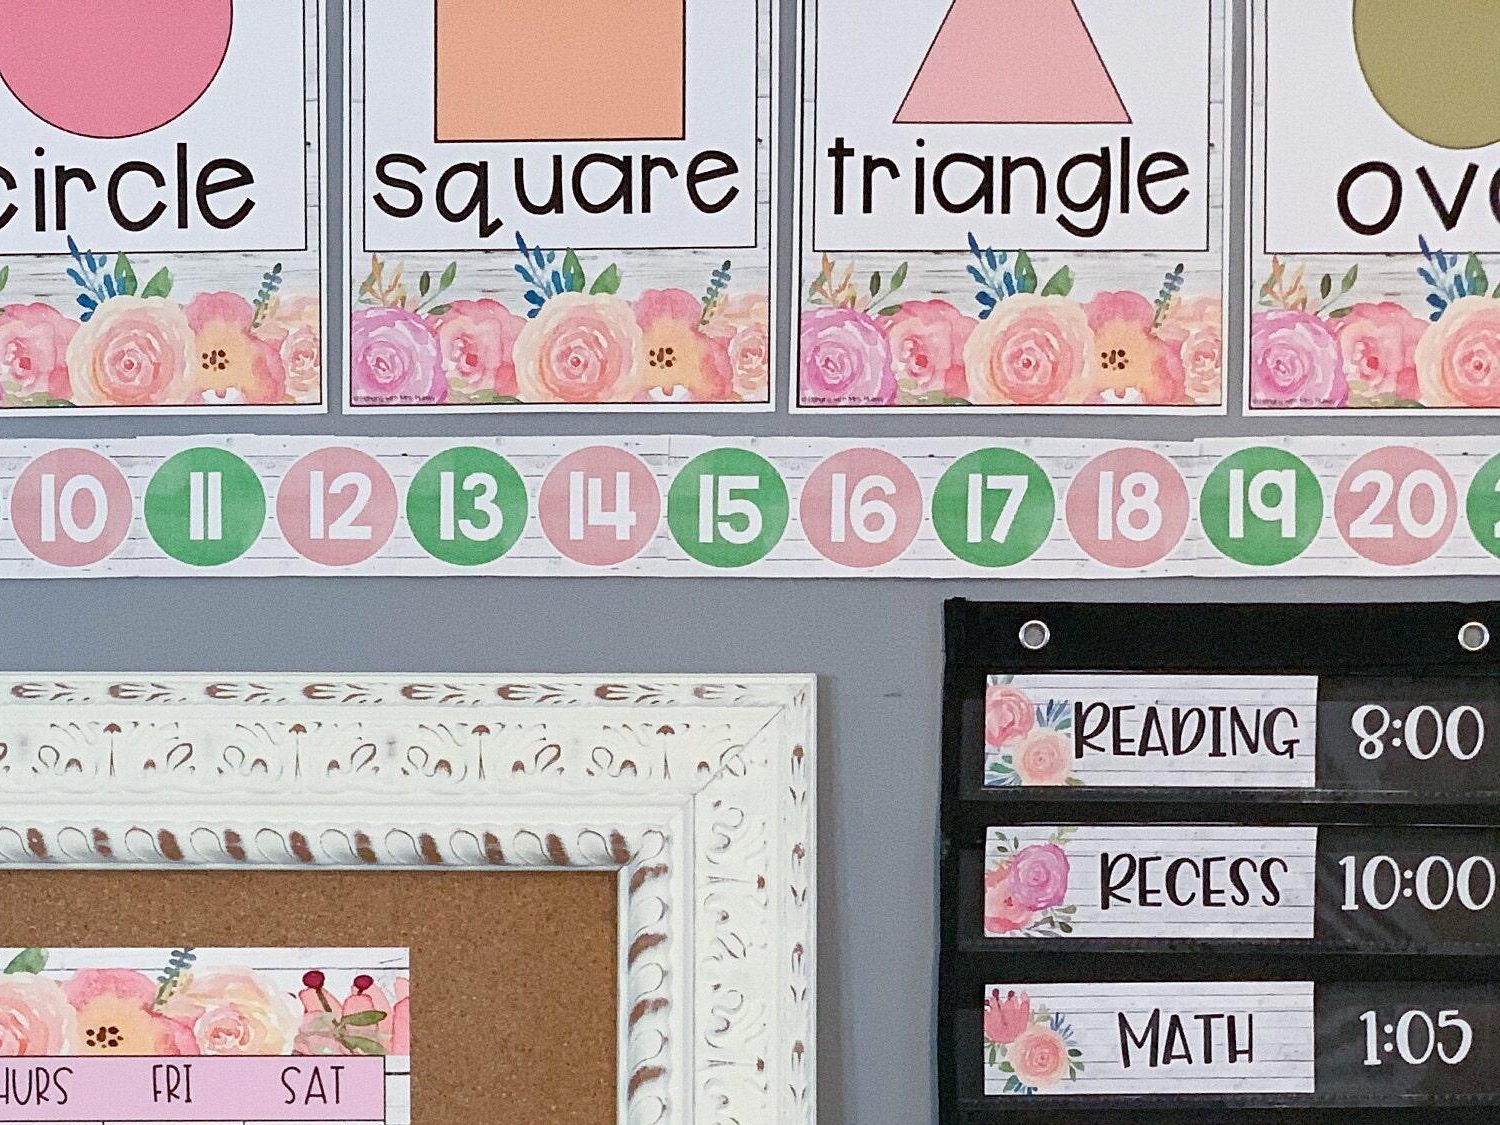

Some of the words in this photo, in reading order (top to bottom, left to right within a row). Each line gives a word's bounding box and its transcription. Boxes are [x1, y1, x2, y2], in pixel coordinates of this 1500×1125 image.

[372, 149, 740, 237] square
[827, 136, 1190, 238] triangle
[1336, 160, 1500, 236] ov
[41, 473, 106, 544] 10
[189, 471, 221, 540] 11
[310, 470, 372, 540] 12
[440, 472, 504, 540] 13
[569, 470, 636, 540] 14
[699, 474, 762, 543] 15
[829, 473, 896, 542] 16
[968, 474, 1029, 542] 17
[1098, 473, 1163, 541] 18
[1228, 469, 1296, 538] 19
[1349, 470, 1447, 539] 20
[1073, 701, 1300, 759] READING
[1351, 704, 1484, 761] 8:00
[1101, 853, 1288, 910] RECESS
[1338, 855, 1496, 911] 10:00
[1117, 1009, 1252, 1068] MATH
[1359, 1009, 1473, 1066] 1:05
[152, 1064, 192, 1104] FRI
[281, 1065, 345, 1104] SAT
